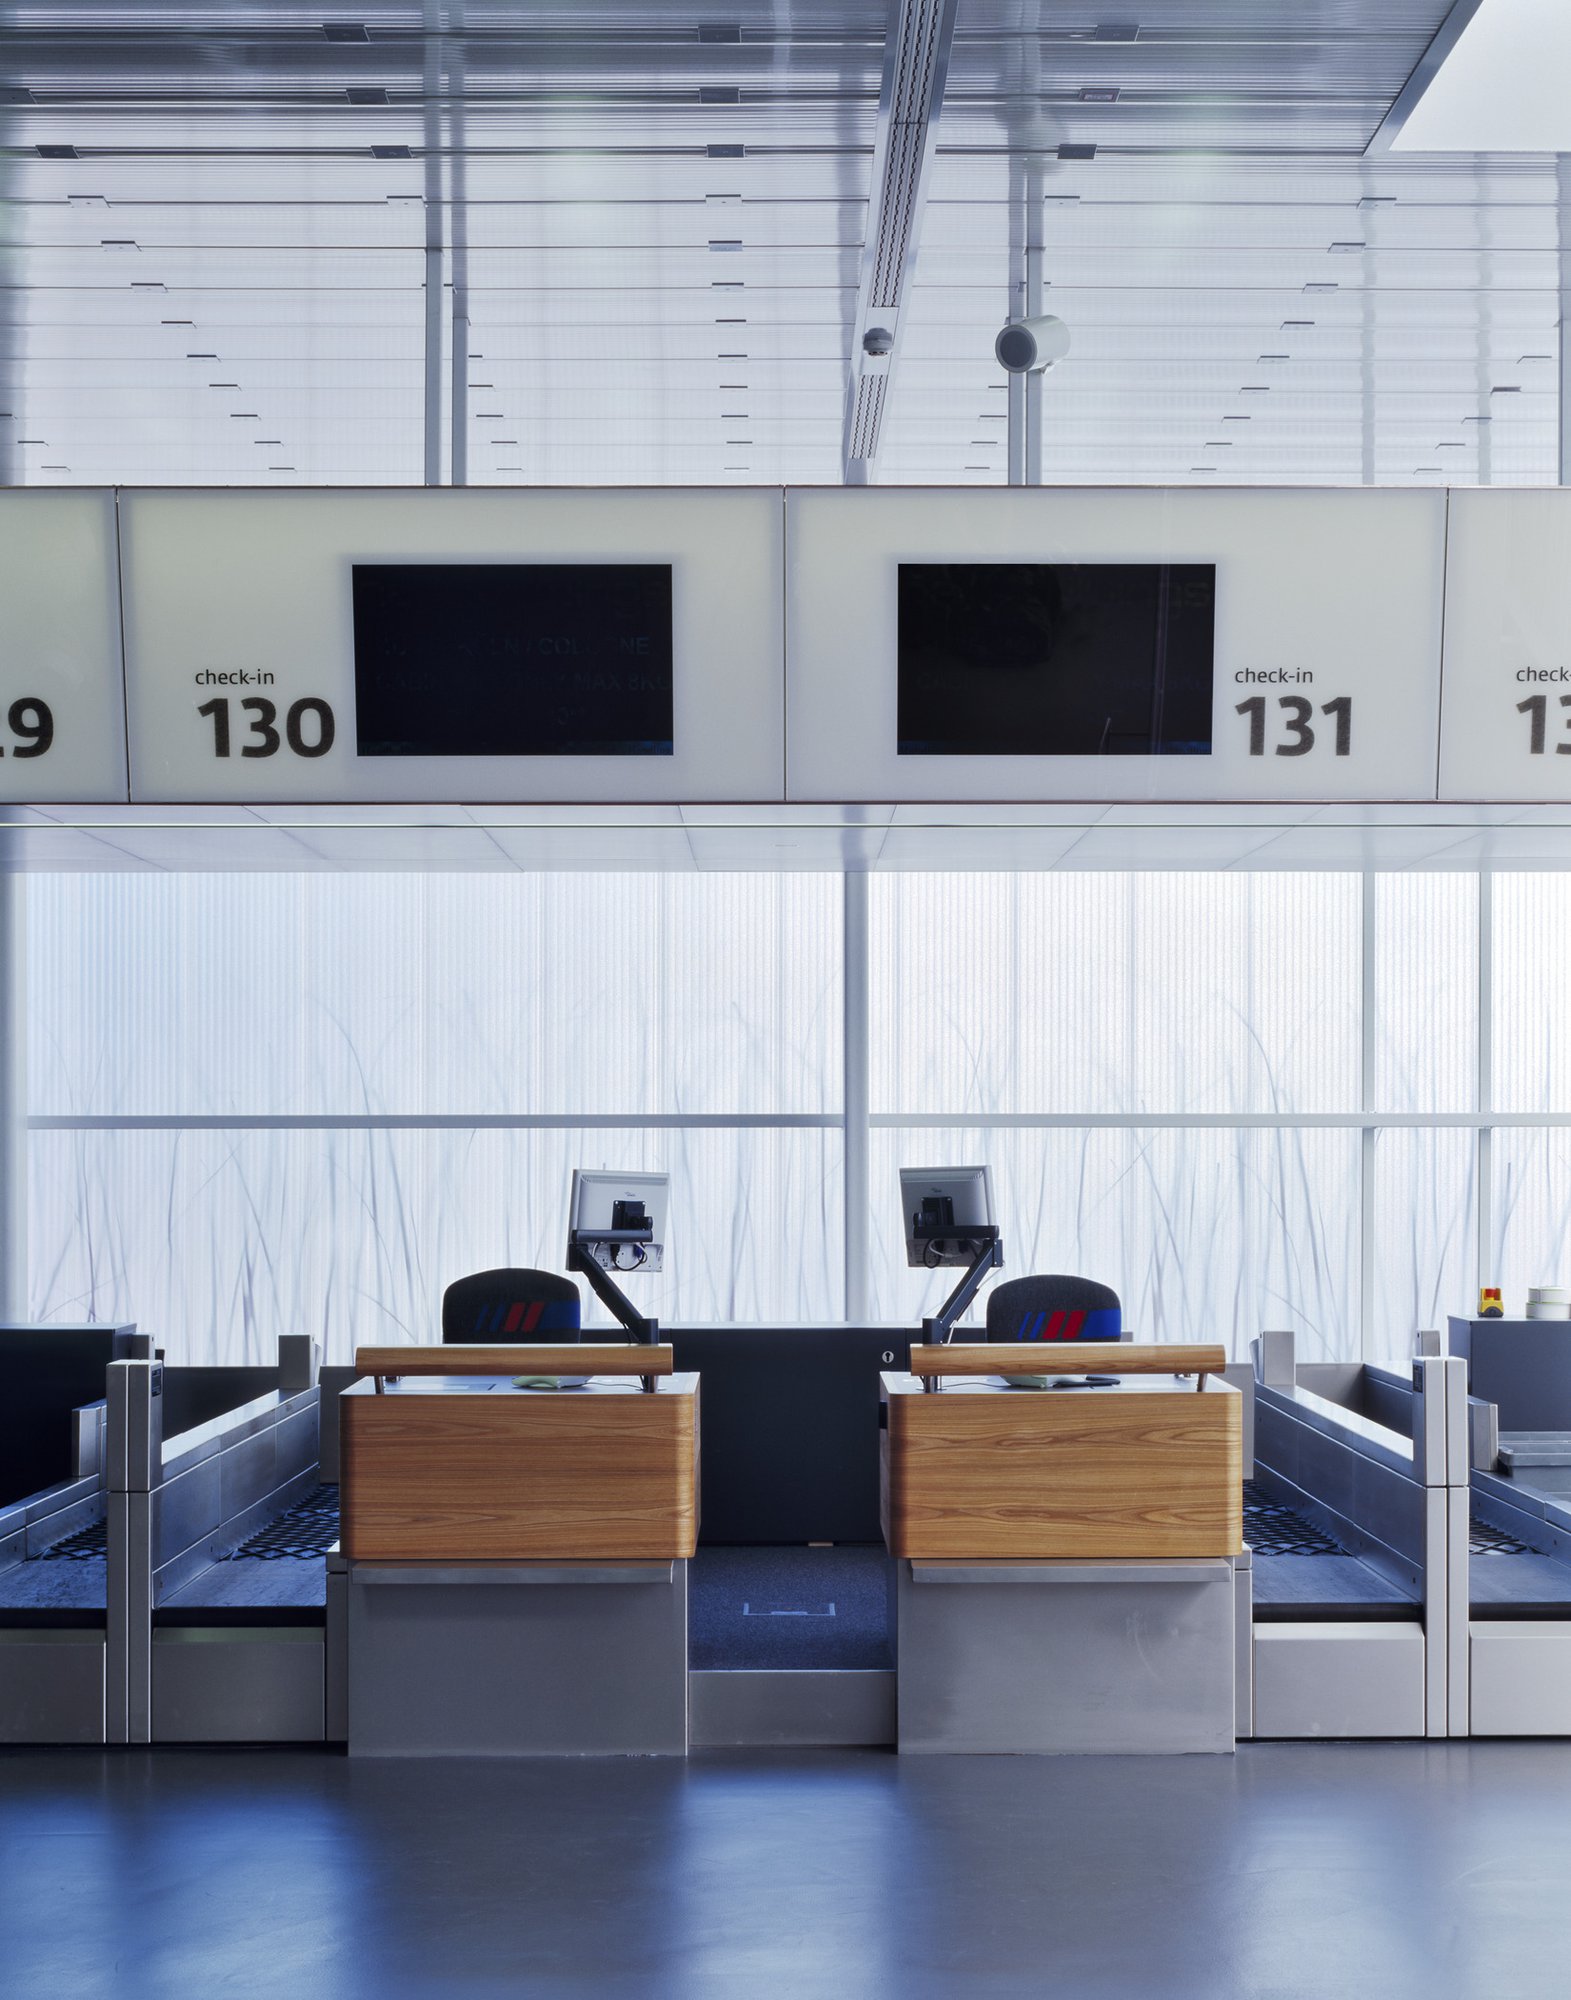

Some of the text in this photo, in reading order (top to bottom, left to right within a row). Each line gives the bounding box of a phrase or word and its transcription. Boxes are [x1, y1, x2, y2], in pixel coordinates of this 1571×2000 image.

[195, 669, 274, 686] check-in
[1234, 668, 1313, 684] check-in
[1516, 667, 1571, 682] check
[0, 697, 54, 758] 9
[197, 697, 335, 759] 130
[1235, 696, 1351, 757] 131
